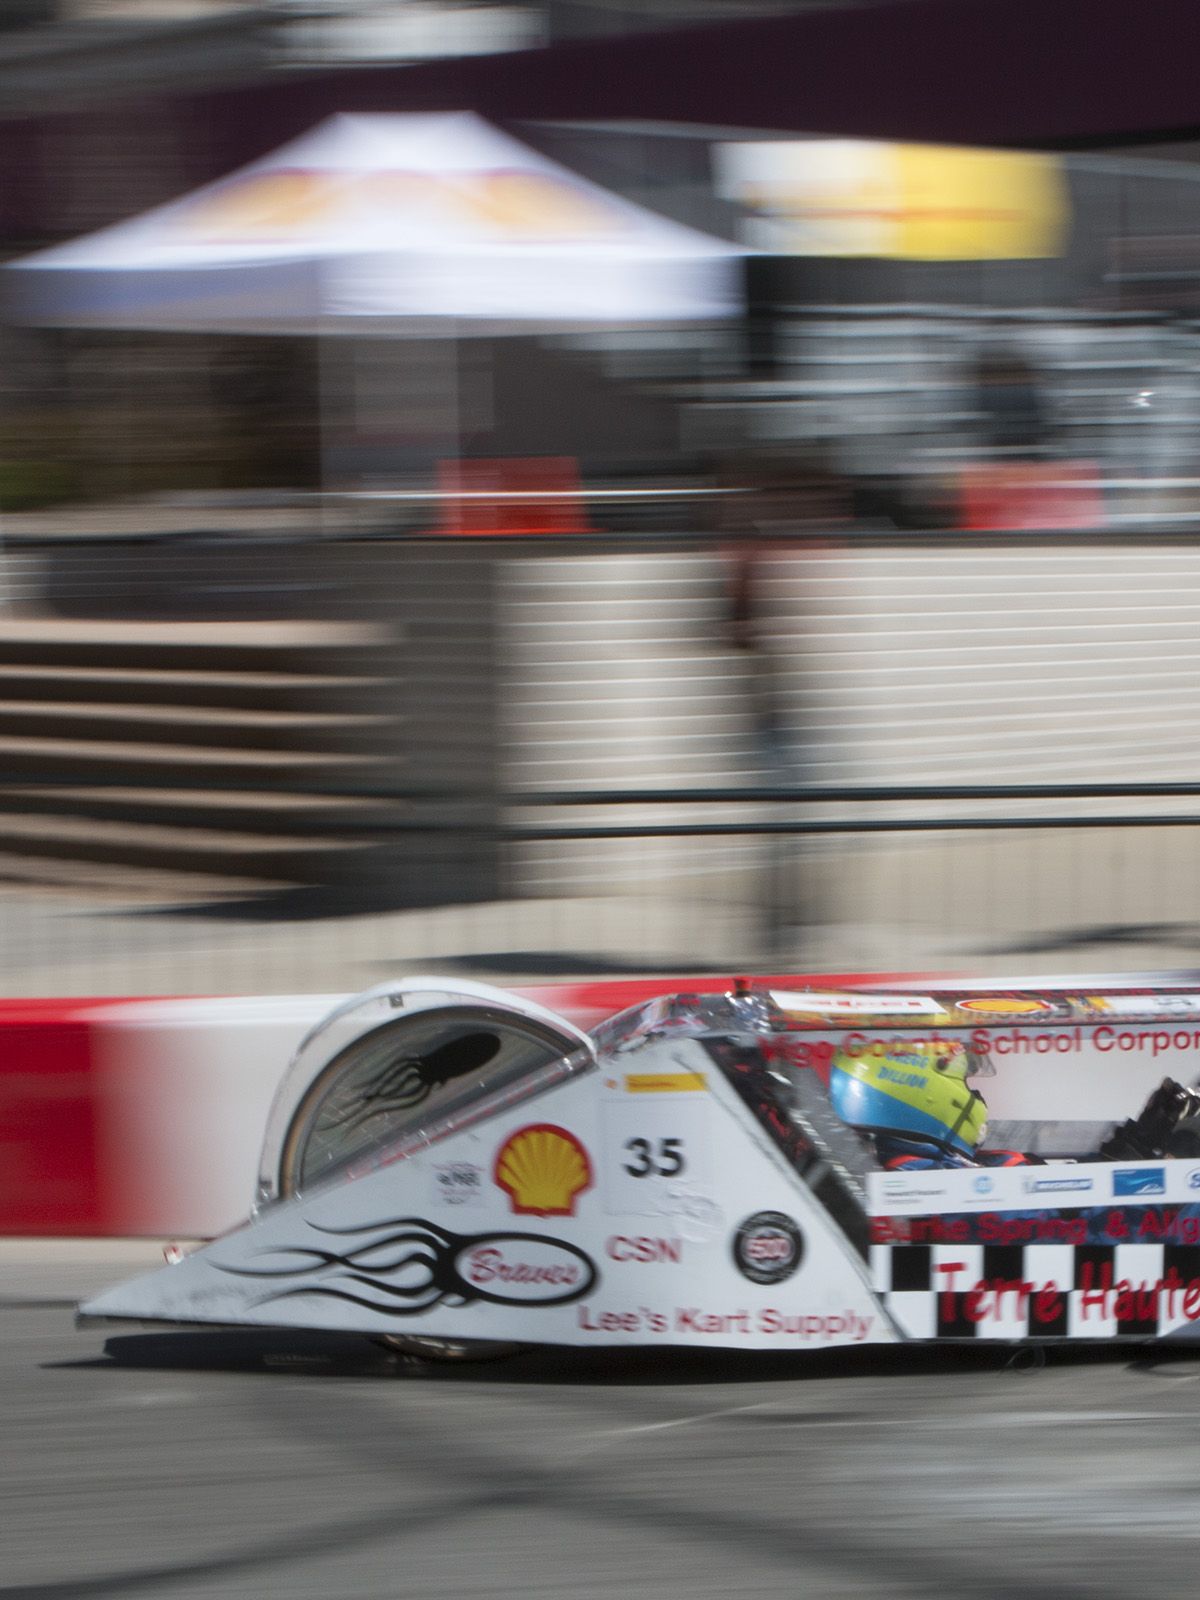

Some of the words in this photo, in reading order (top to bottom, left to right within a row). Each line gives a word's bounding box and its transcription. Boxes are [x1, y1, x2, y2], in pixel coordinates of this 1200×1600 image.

[969, 1028, 1081, 1056] School
[623, 1137, 684, 1178] 35
[976, 1211, 1088, 1245] Spring
[1105, 1211, 1130, 1238] &
[606, 1233, 683, 1263] CSN
[935, 1262, 1063, 1322] Terre
[577, 1306, 668, 1332] Lee's
[675, 1308, 751, 1333] Kart
[758, 1309, 876, 1341] Supply
